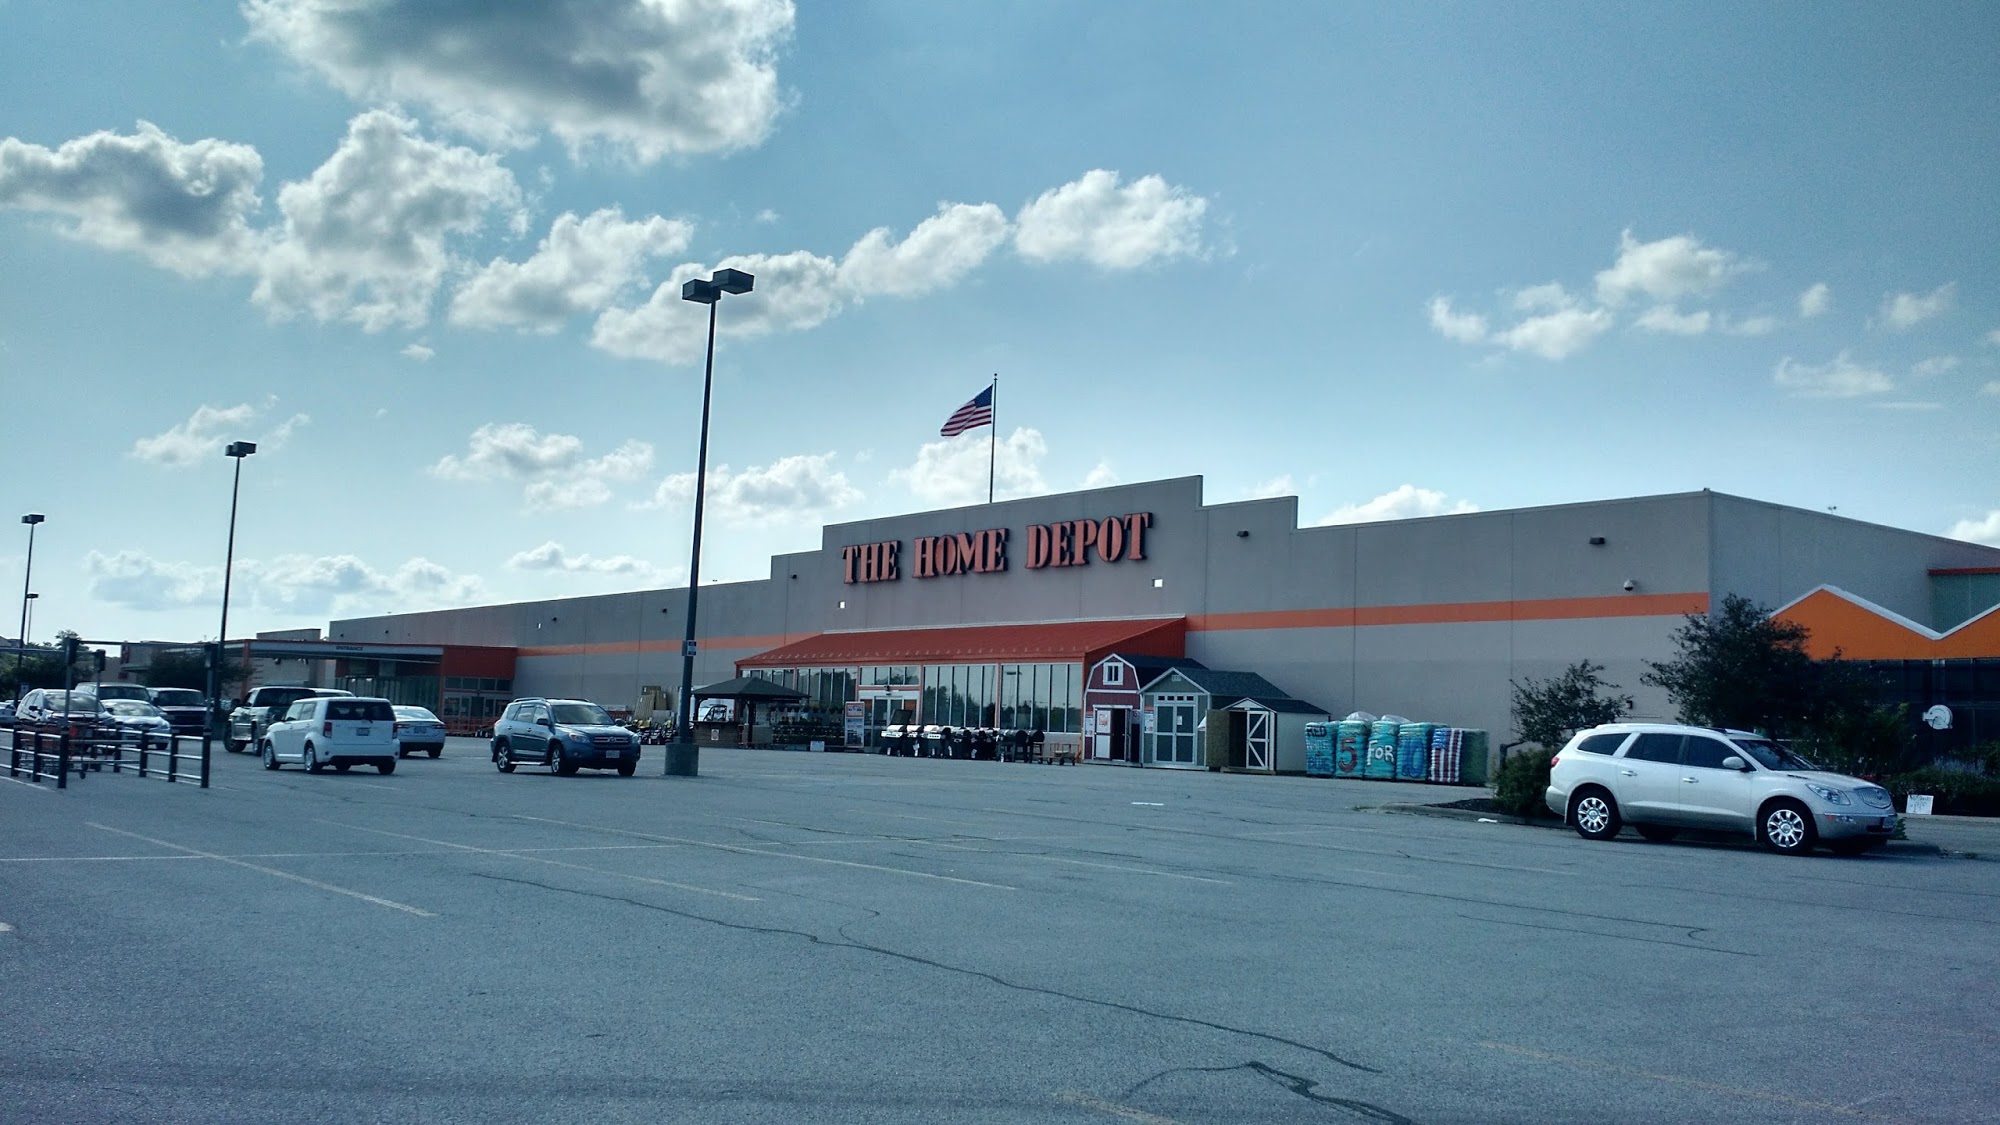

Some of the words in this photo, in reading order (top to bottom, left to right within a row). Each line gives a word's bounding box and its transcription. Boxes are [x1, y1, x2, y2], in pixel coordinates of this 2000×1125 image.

[842, 540, 901, 584] THE
[912, 528, 1009, 579] HOME
[1025, 512, 1153, 570] DEPOT
[1306, 725, 1327, 737] RED
[1338, 737, 1357, 772] 5
